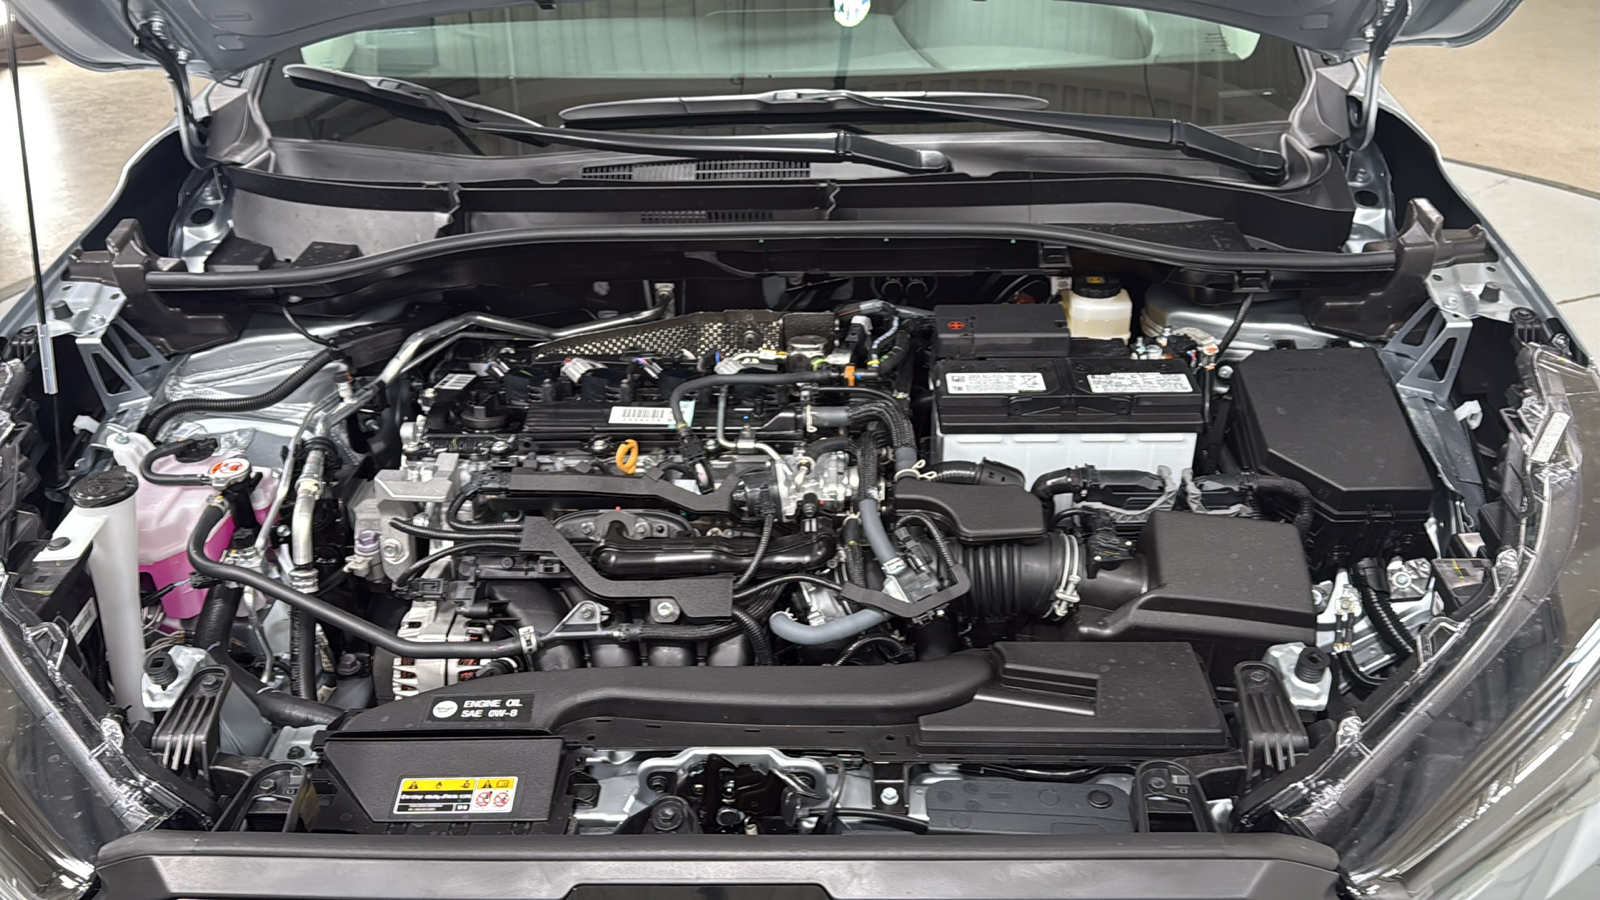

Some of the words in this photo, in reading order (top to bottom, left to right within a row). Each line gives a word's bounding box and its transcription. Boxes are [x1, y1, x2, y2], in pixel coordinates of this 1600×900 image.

[463, 699, 502, 707] ENGINE
[505, 698, 523, 706] OIL
[461, 709, 483, 717] SAE
[487, 709, 518, 717] 0W-8
